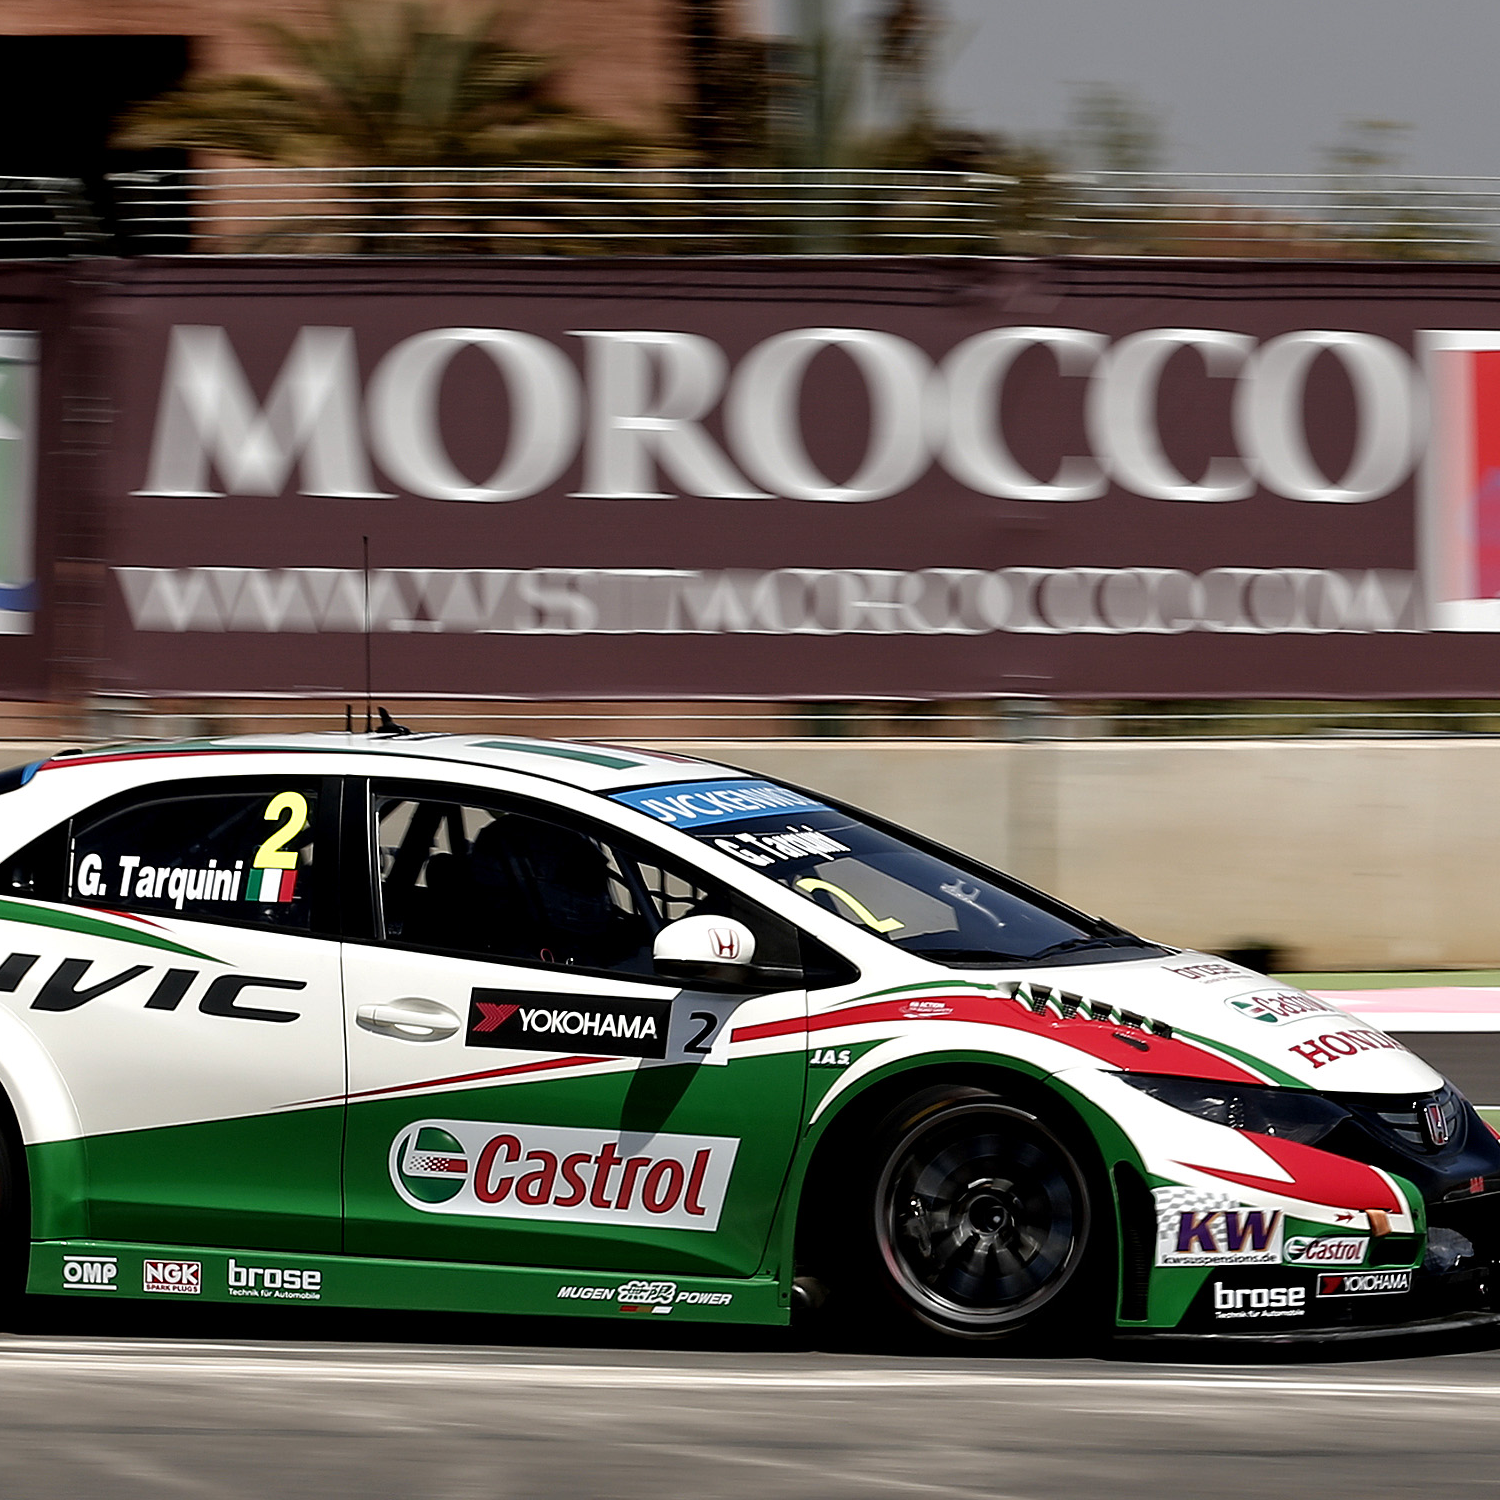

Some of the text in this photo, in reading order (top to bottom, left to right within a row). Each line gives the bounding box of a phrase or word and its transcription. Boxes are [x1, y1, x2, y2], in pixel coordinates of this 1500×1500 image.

[130, 323, 1427, 503] MOROCCO
[253, 791, 308, 869] 2
[77, 853, 243, 910] G. Tarquini
[795, 877, 905, 933] 2
[519, 1008, 657, 1039] YOKOHAMA
[683, 1011, 718, 1054] 2
[473, 1133, 712, 1216] Castrol
[1176, 1209, 1282, 1253] KW
[1305, 1239, 1364, 1261] Castrol
[63, 1261, 117, 1285] OMP
[146, 1262, 199, 1285] NGK
[146, 1284, 198, 1293] SPARK PLUGS
[228, 1258, 321, 1290] brose
[1343, 1274, 1409, 1292] YOKOHAMA
[228, 1287, 260, 1297] Technik
[274, 1290, 321, 1300] Automobile
[557, 1286, 616, 1300] MUGEN
[675, 1291, 733, 1305] POWER
[1214, 1282, 1306, 1310] brose
